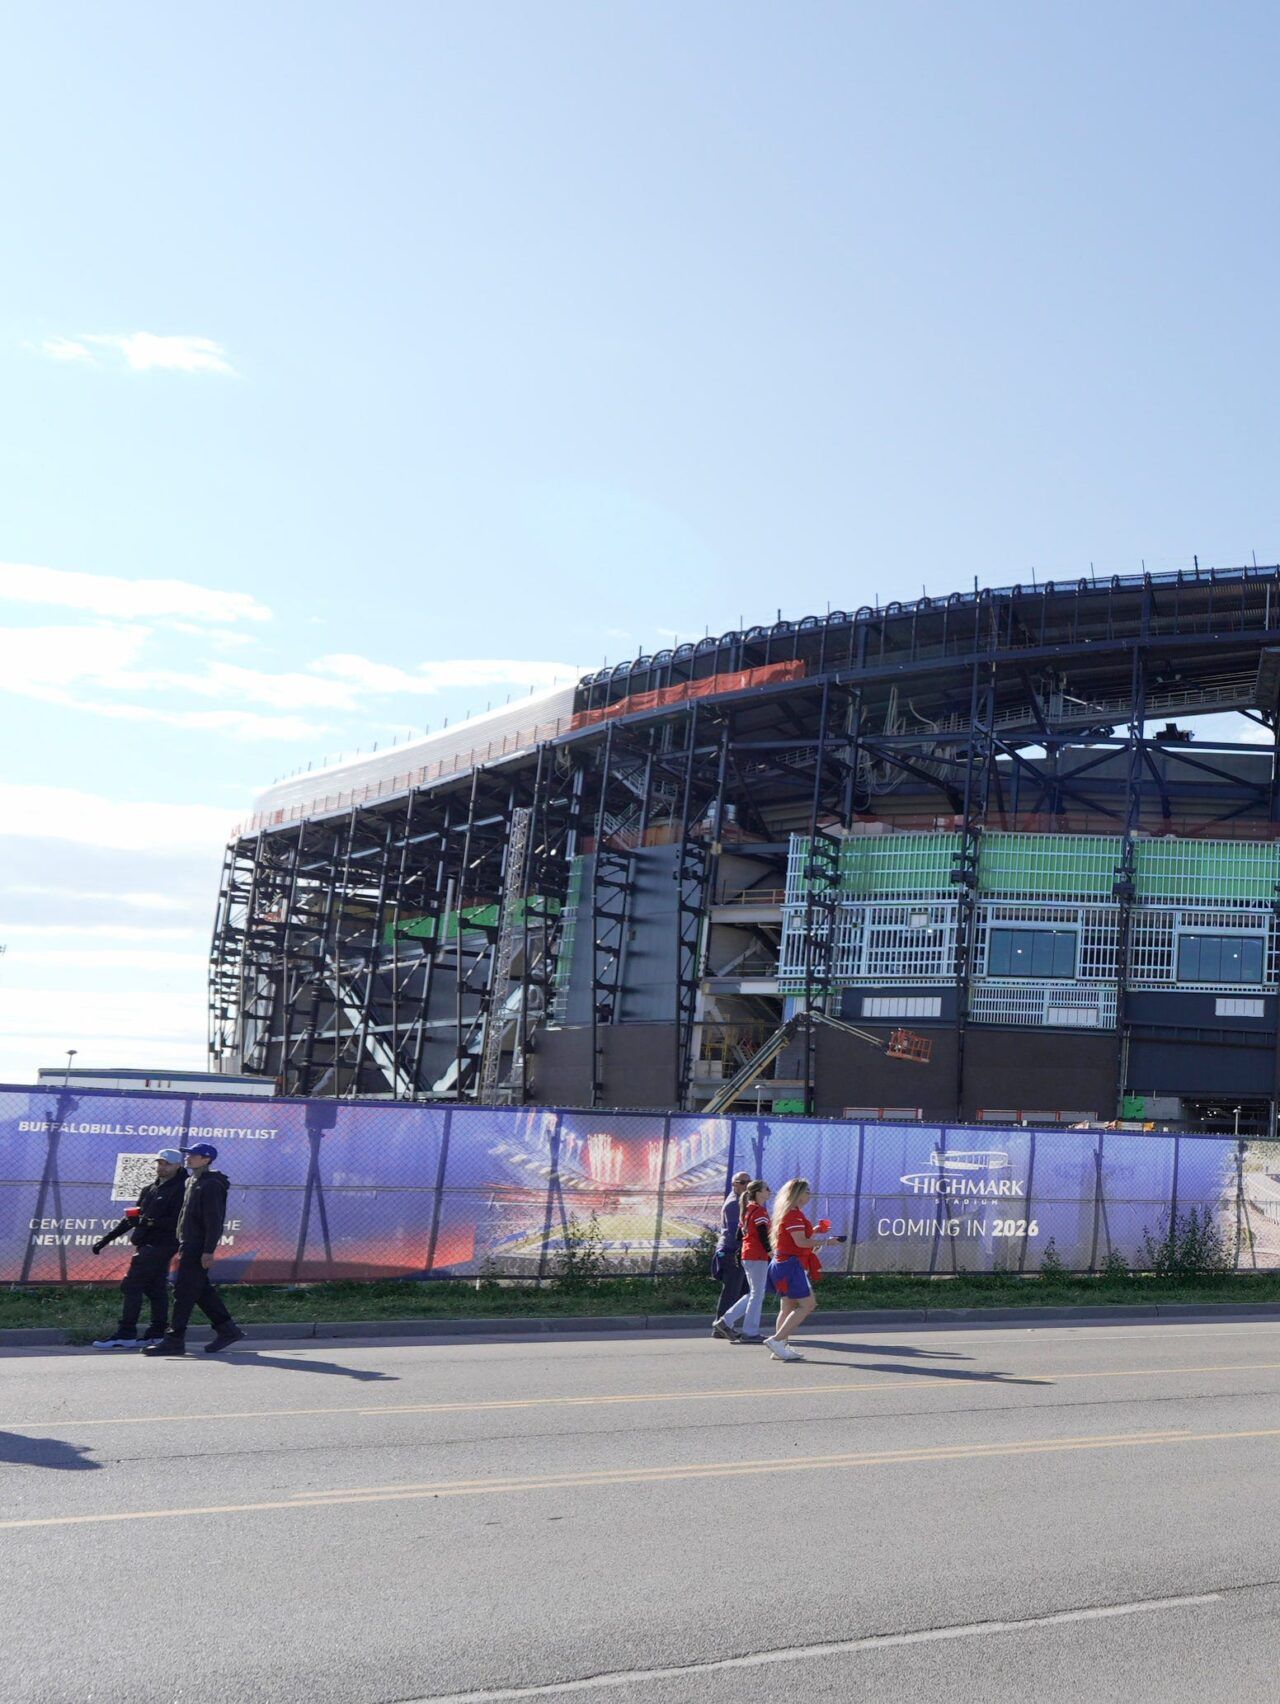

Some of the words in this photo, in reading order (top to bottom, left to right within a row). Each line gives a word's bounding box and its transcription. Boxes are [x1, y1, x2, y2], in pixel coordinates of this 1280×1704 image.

[18, 1121, 279, 1140] BUFFALOBILLS.COM/PRIORITYLIST
[913, 1177, 1025, 1196] HIGHMARK
[29, 1217, 98, 1231] CEMENT
[223, 1219, 241, 1231] HE
[877, 1217, 960, 1237] COMING
[967, 1218, 986, 1237] IN
[992, 1219, 1039, 1238] 2026
[31, 1234, 71, 1247] NEW
